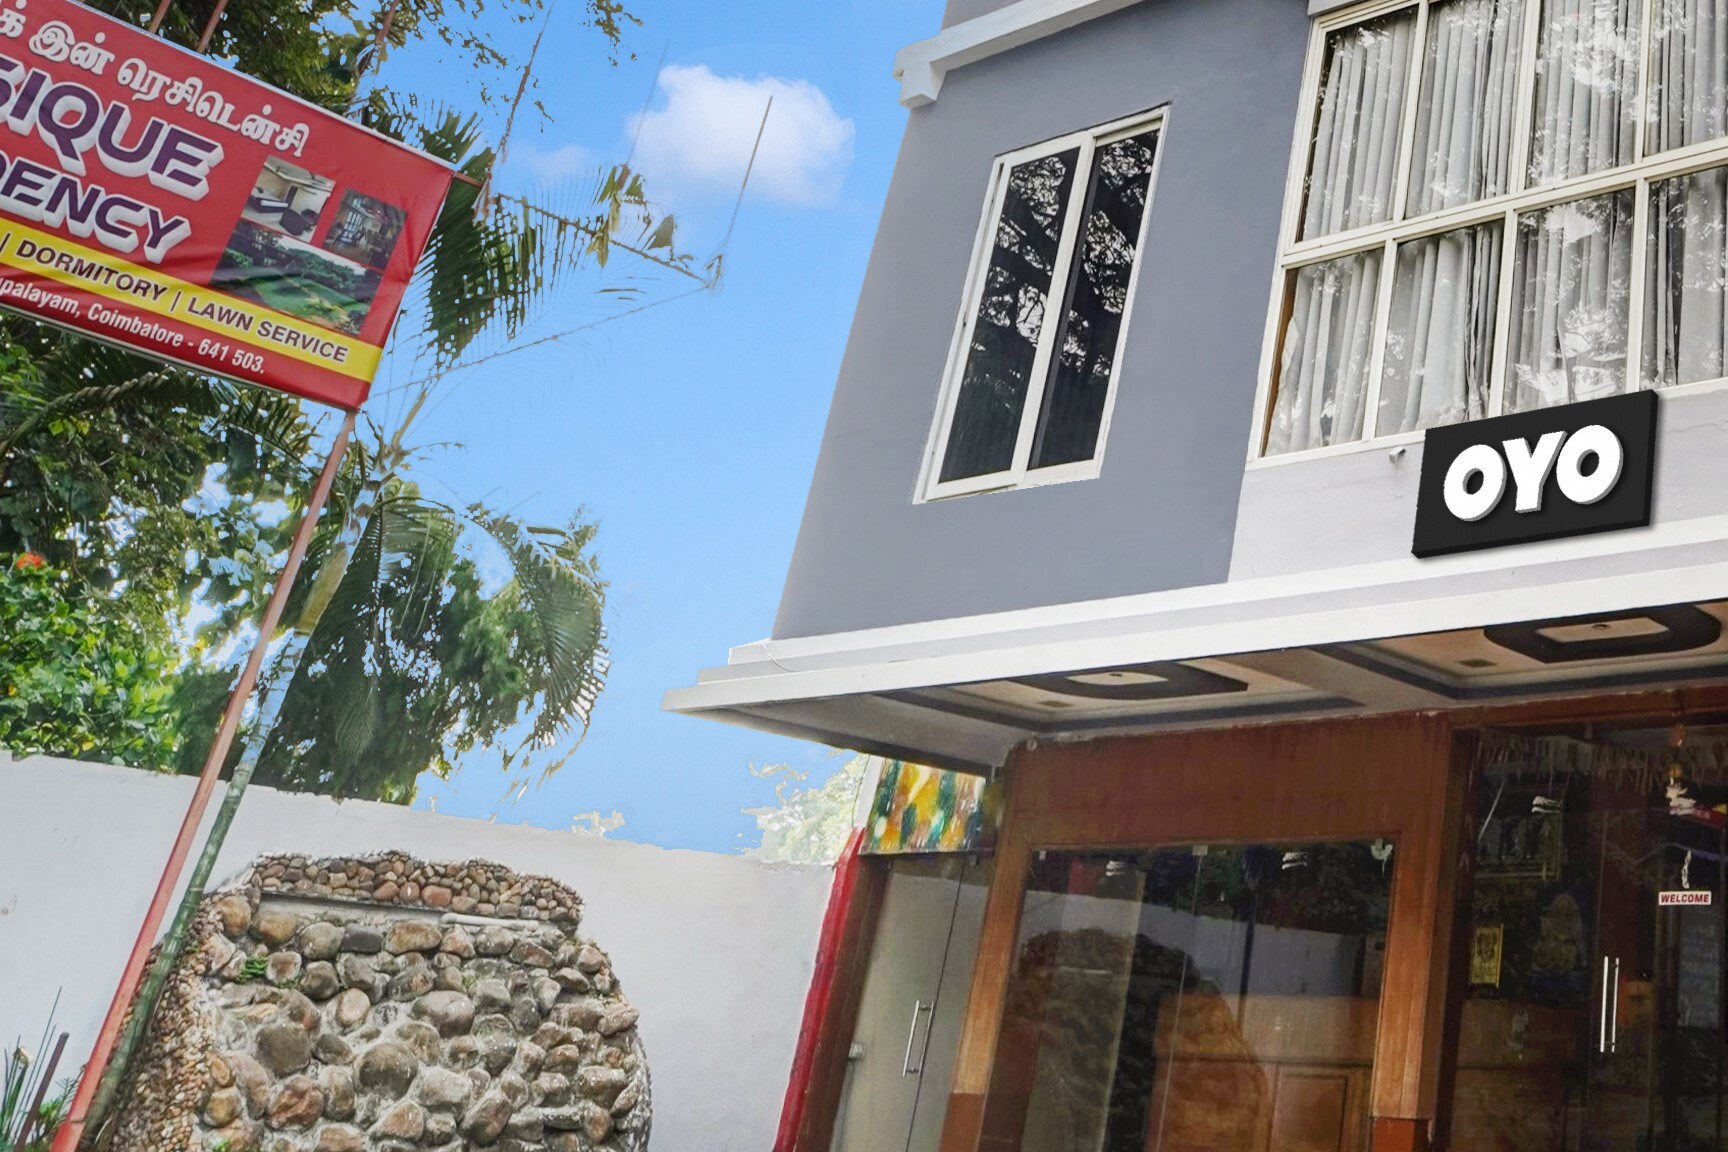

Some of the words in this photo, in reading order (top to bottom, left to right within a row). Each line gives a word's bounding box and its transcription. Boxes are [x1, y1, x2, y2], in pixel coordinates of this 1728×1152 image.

[29, 20, 116, 76] இன்
[117, 57, 310, 158] ரெசிடென்சி
[0, 151, 192, 265] ENCY
[0, 275, 81, 318] palayam,
[87, 302, 184, 348] Coimbatore
[198, 338, 230, 362] 641
[231, 351, 265, 374] 503.
[16, 239, 168, 302] DORMITORY
[187, 297, 254, 331] LAWN
[257, 320, 348, 363] SERVICE
[1443, 424, 1624, 522] OYO
[1660, 893, 1710, 903] WELCOME
